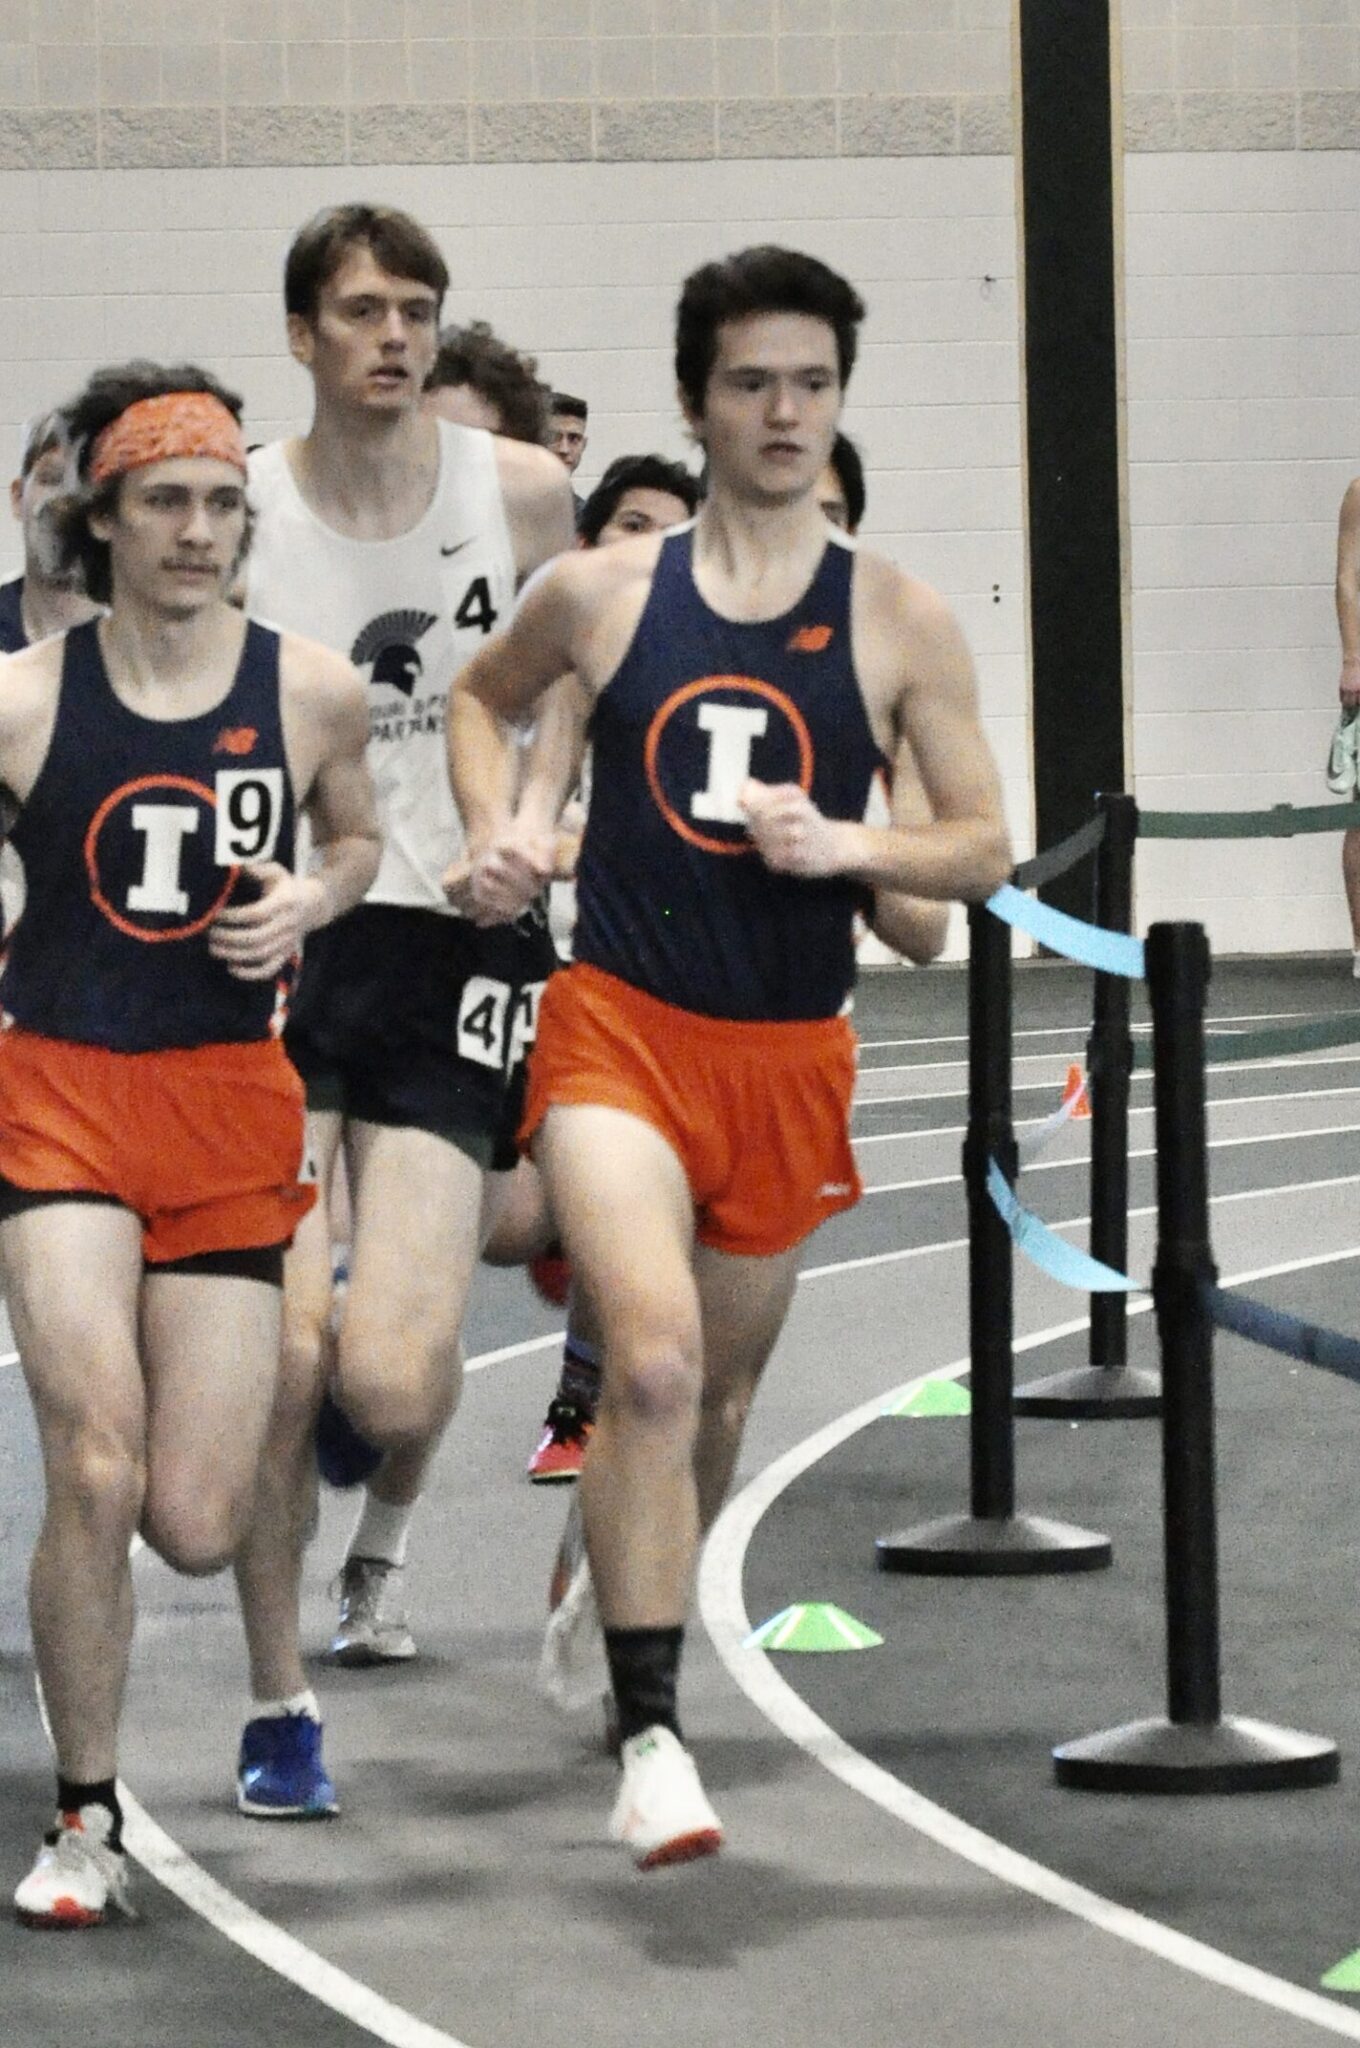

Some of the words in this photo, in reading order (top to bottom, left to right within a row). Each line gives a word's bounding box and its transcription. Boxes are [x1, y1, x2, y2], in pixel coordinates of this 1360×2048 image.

[455, 576, 498, 634] 4
[691, 703, 768, 824] I
[228, 780, 272, 857] 9
[126, 803, 200, 915] I
[462, 994, 497, 1051] 4
